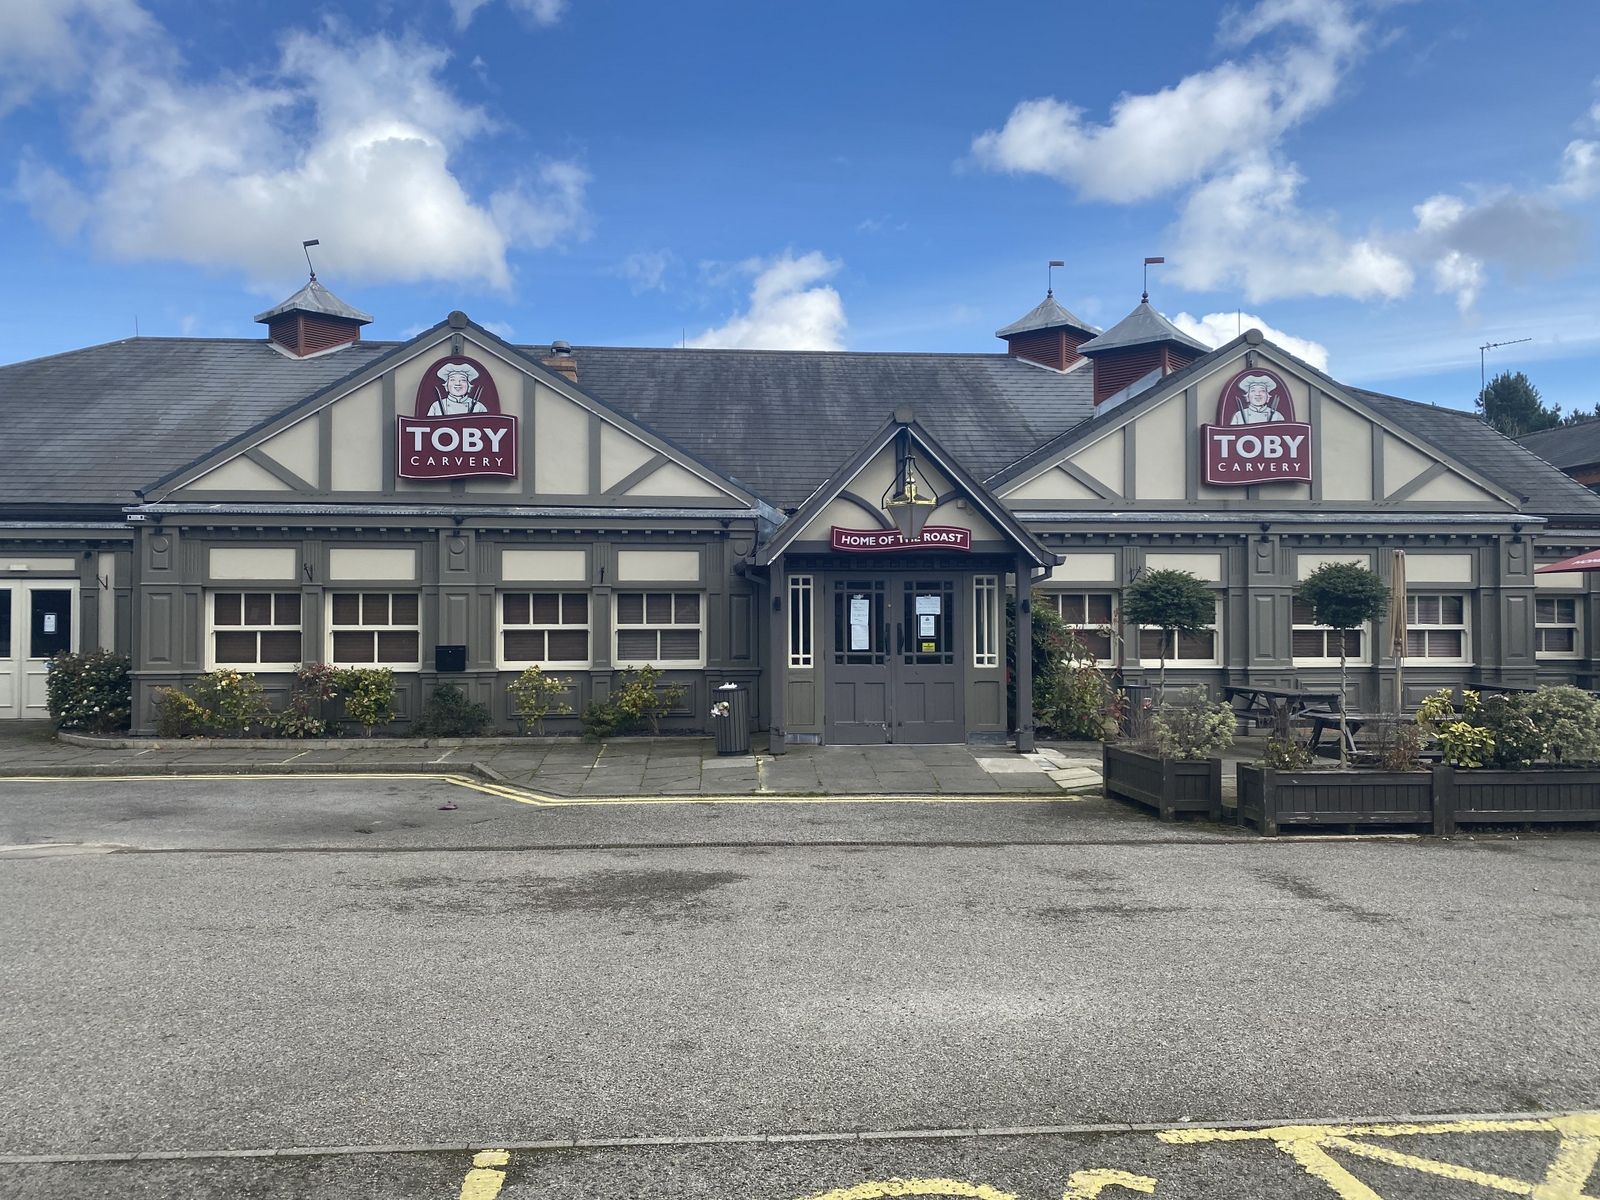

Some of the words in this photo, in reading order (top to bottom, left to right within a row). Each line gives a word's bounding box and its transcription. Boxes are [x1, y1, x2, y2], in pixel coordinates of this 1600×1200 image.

[406, 427, 508, 452] TOBY
[1213, 435, 1305, 458] TOBY
[410, 456, 503, 466] CARVERY
[1218, 463, 1301, 472] CARVERY
[841, 535, 876, 546] HOME
[879, 535, 894, 545] OF
[923, 532, 963, 543] ROAST
